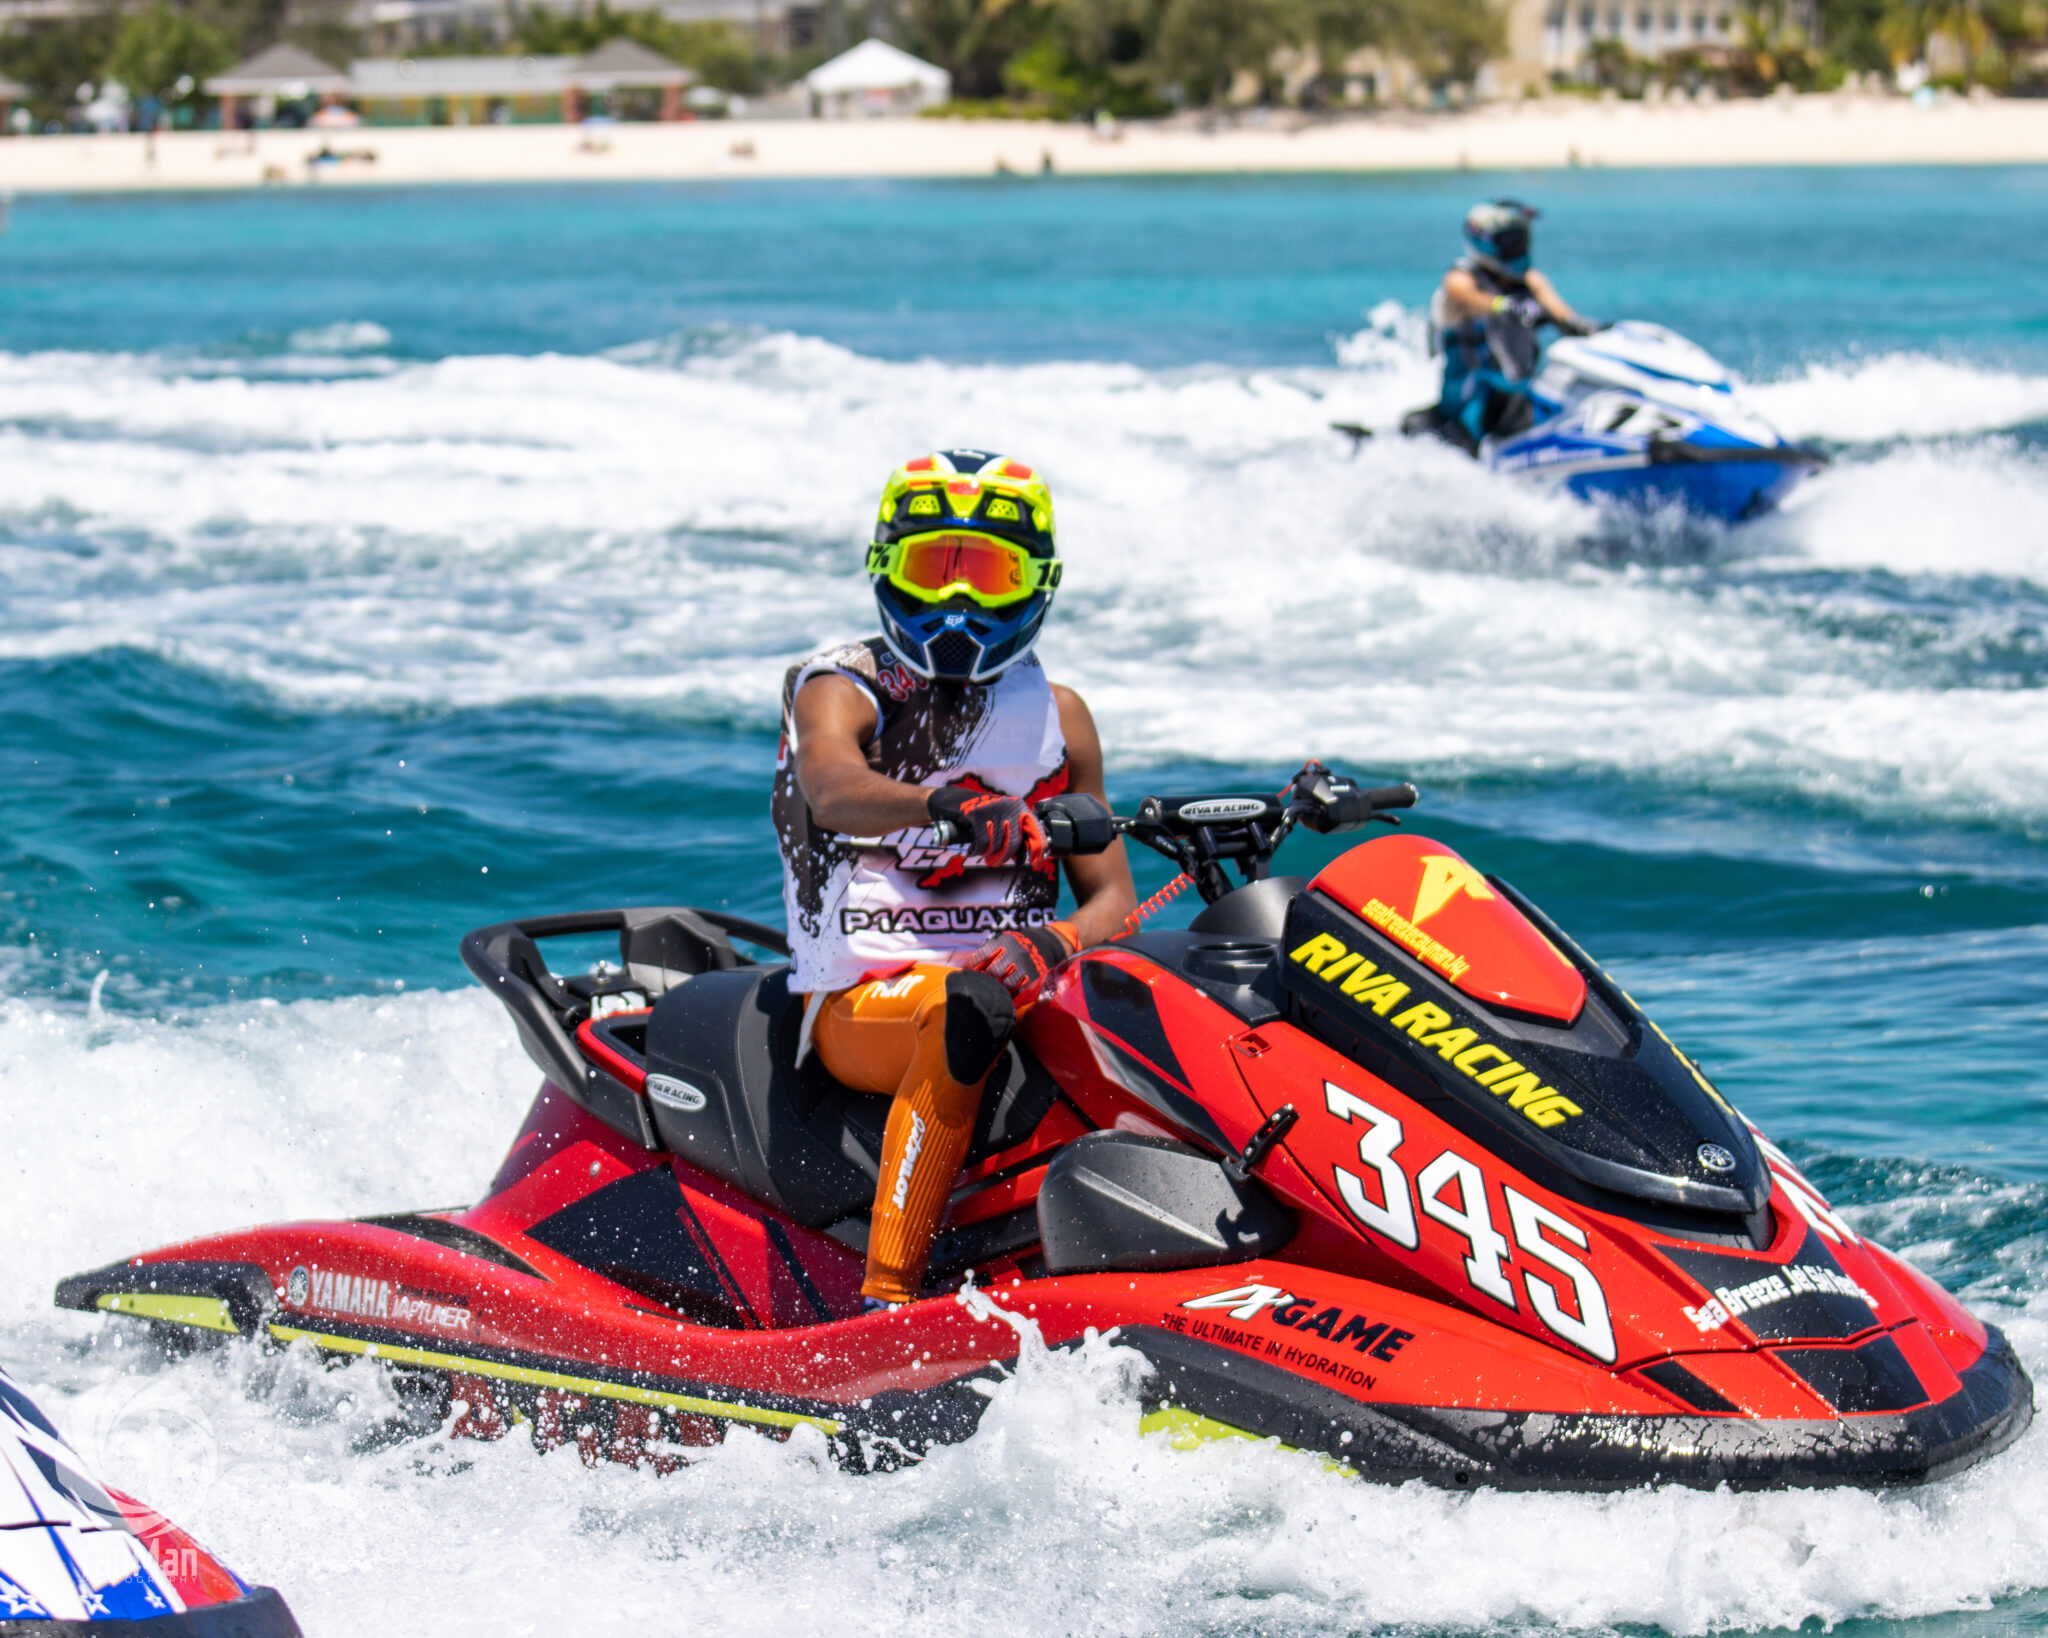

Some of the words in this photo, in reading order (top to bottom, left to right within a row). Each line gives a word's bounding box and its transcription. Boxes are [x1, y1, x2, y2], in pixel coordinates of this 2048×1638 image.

[1183, 806, 1211, 816] RIVA
[1212, 803, 1259, 814] RACING
[1289, 932, 1412, 1018] RIVA
[1390, 1001, 1584, 1129] RACING
[662, 1085, 700, 1103] RACING
[1322, 1079, 1618, 1365] 345
[312, 1270, 389, 1320] YAMAHA
[1681, 1297, 1731, 1333] Sea
[1714, 1273, 1791, 1317] Breeze
[1781, 1264, 1819, 1295] Jet
[1162, 1312, 1188, 1333] THE
[1192, 1319, 1265, 1351] ULTIMATE
[1264, 1340, 1282, 1357] IN
[1283, 1347, 1377, 1391] HYDRATION
